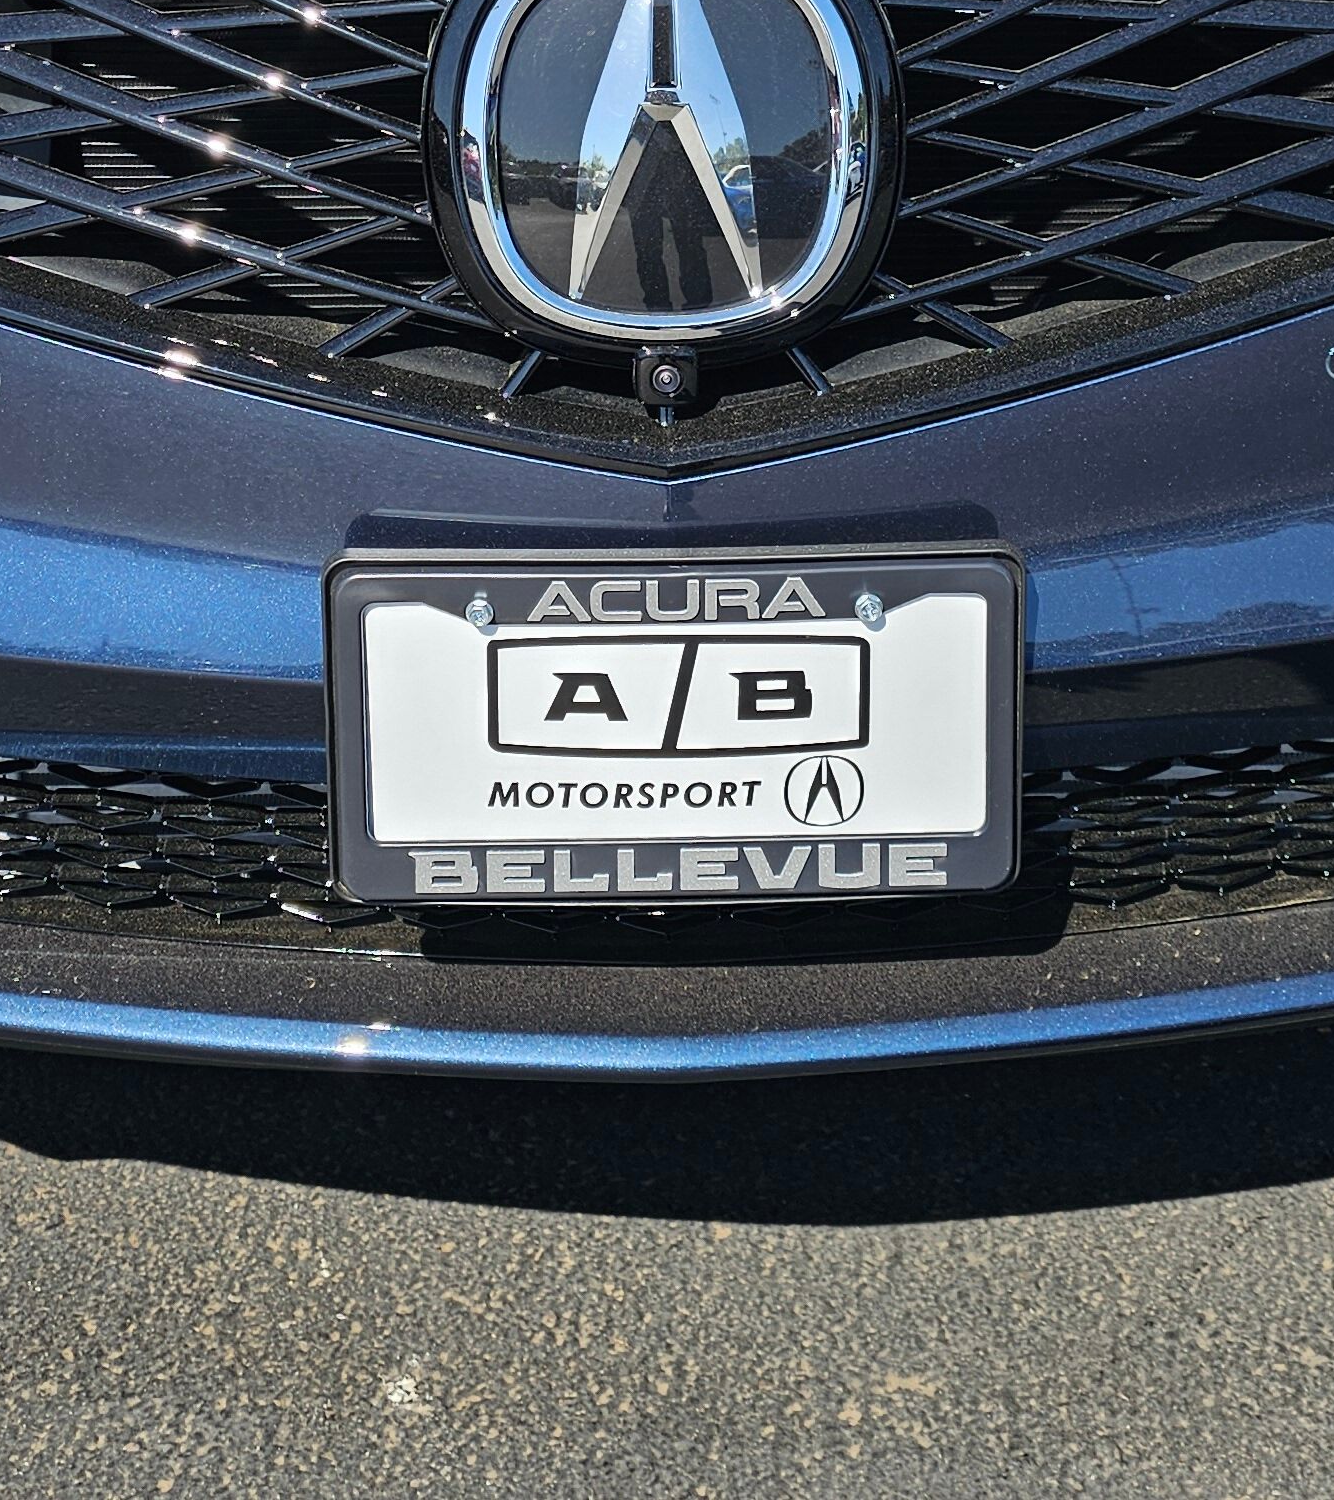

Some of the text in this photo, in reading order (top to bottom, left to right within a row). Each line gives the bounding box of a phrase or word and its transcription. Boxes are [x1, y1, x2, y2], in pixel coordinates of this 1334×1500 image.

[526, 577, 826, 623] ACURA
[544, 670, 813, 722] A B
[487, 779, 763, 811] MOTORSPORT
[407, 842, 948, 895] BELLEVUE
